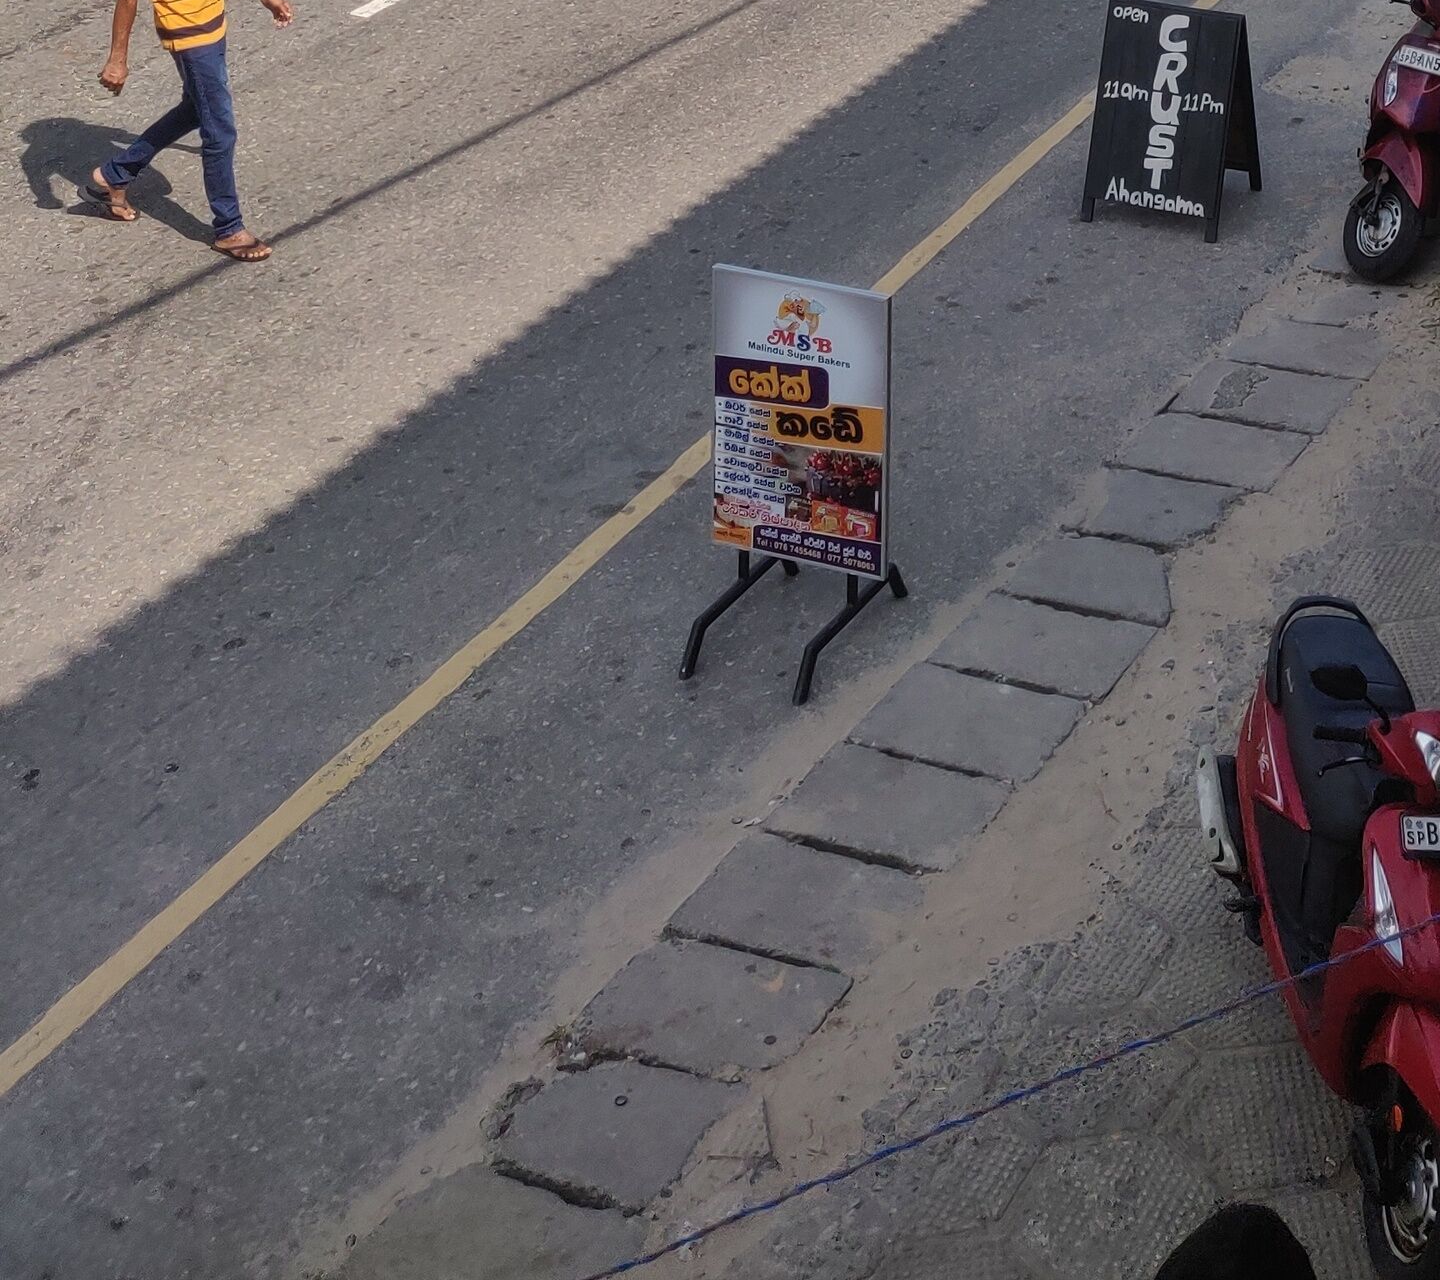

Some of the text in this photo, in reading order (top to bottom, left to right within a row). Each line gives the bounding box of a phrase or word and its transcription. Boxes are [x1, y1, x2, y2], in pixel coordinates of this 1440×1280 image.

[1104, 176, 1205, 218] Ahangama
[748, 341, 851, 369] Malindu Super Bakers
[729, 365, 812, 404] කේක්
[775, 406, 864, 447] කඩේ
[1406, 830, 1426, 846] SP
